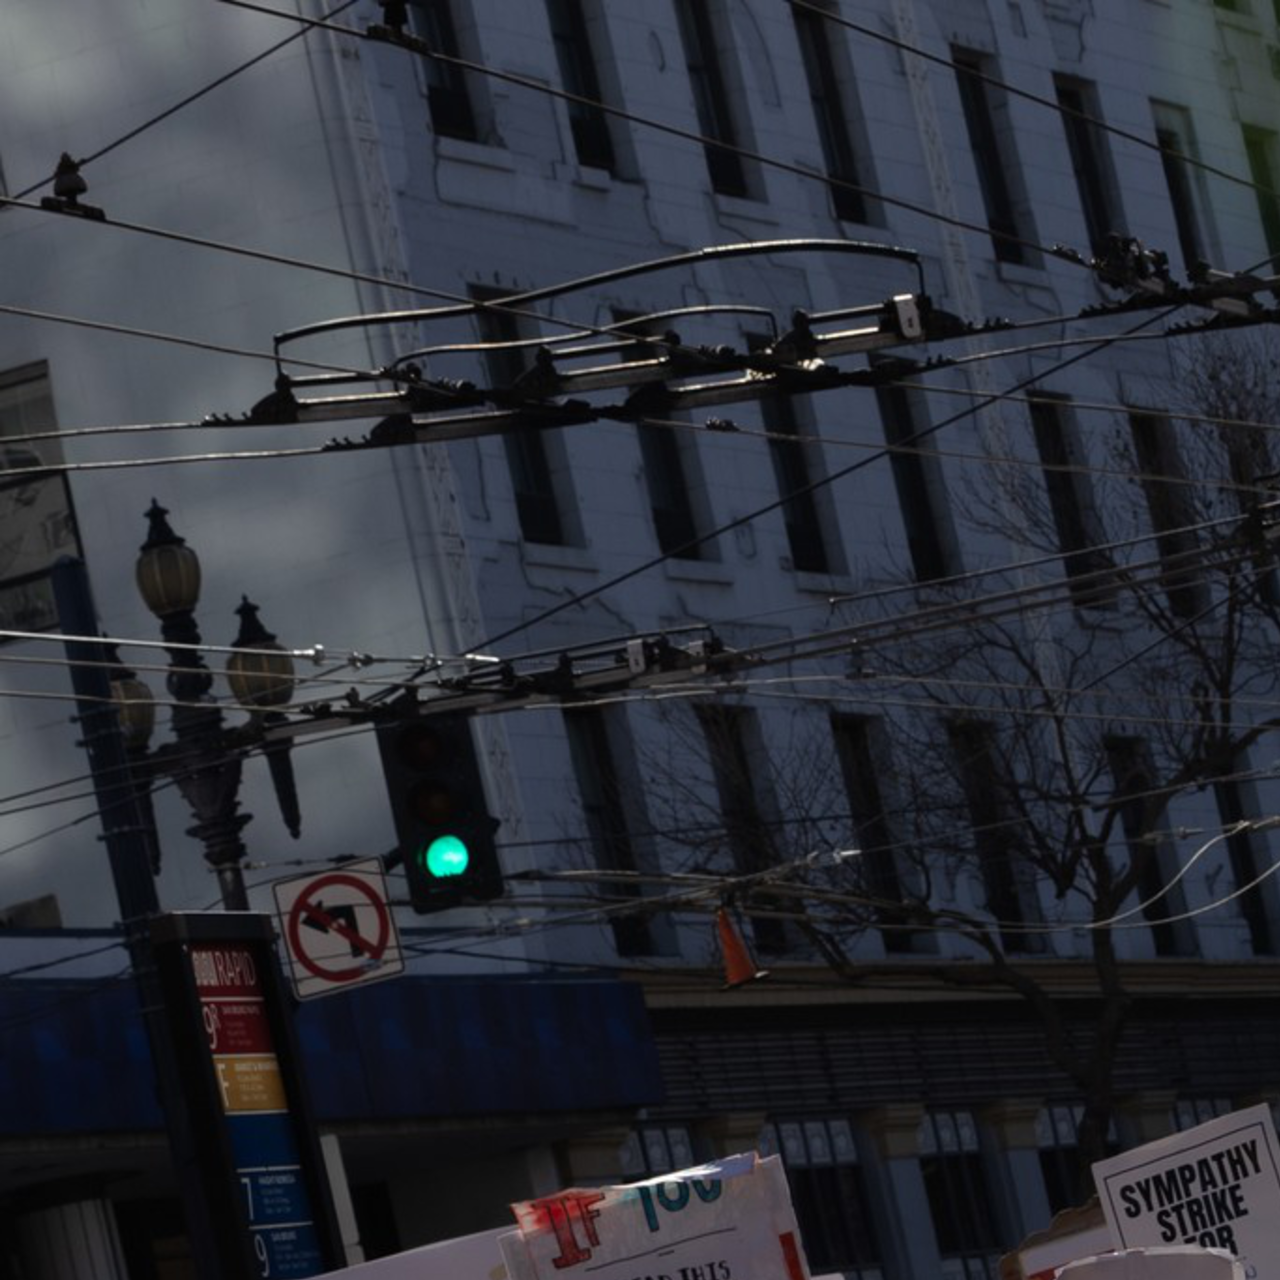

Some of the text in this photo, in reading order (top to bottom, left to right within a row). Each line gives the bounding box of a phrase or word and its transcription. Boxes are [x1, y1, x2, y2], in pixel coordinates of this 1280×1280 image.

[215, 951, 257, 987] RAPID
[1119, 1139, 1262, 1218] SYMPATHY
[1156, 1183, 1248, 1243] STRIKE
[254, 1233, 270, 1278] 9
